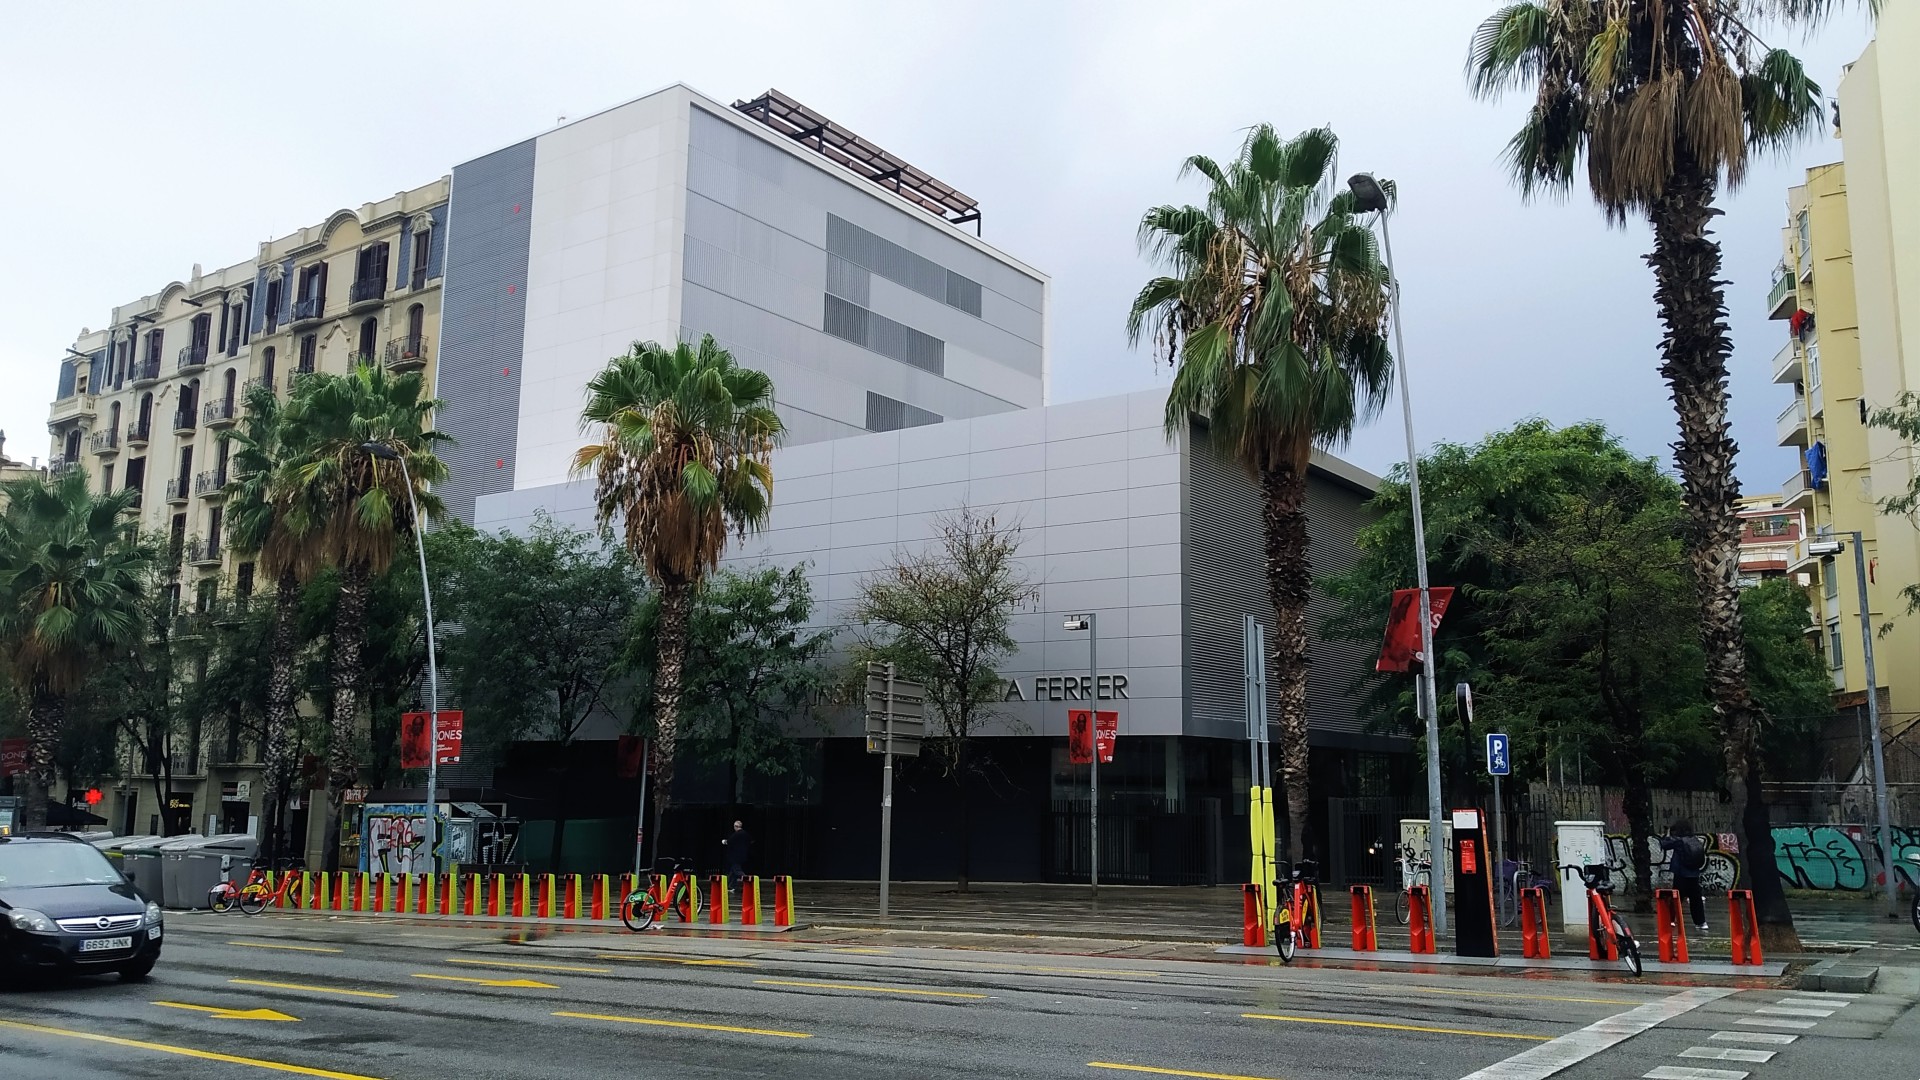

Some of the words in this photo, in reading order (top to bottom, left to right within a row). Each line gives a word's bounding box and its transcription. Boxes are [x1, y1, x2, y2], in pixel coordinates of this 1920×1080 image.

[1035, 675, 1130, 701] FERRER
[1494, 740, 1503, 755] P
[85, 940, 110, 951] 6692
